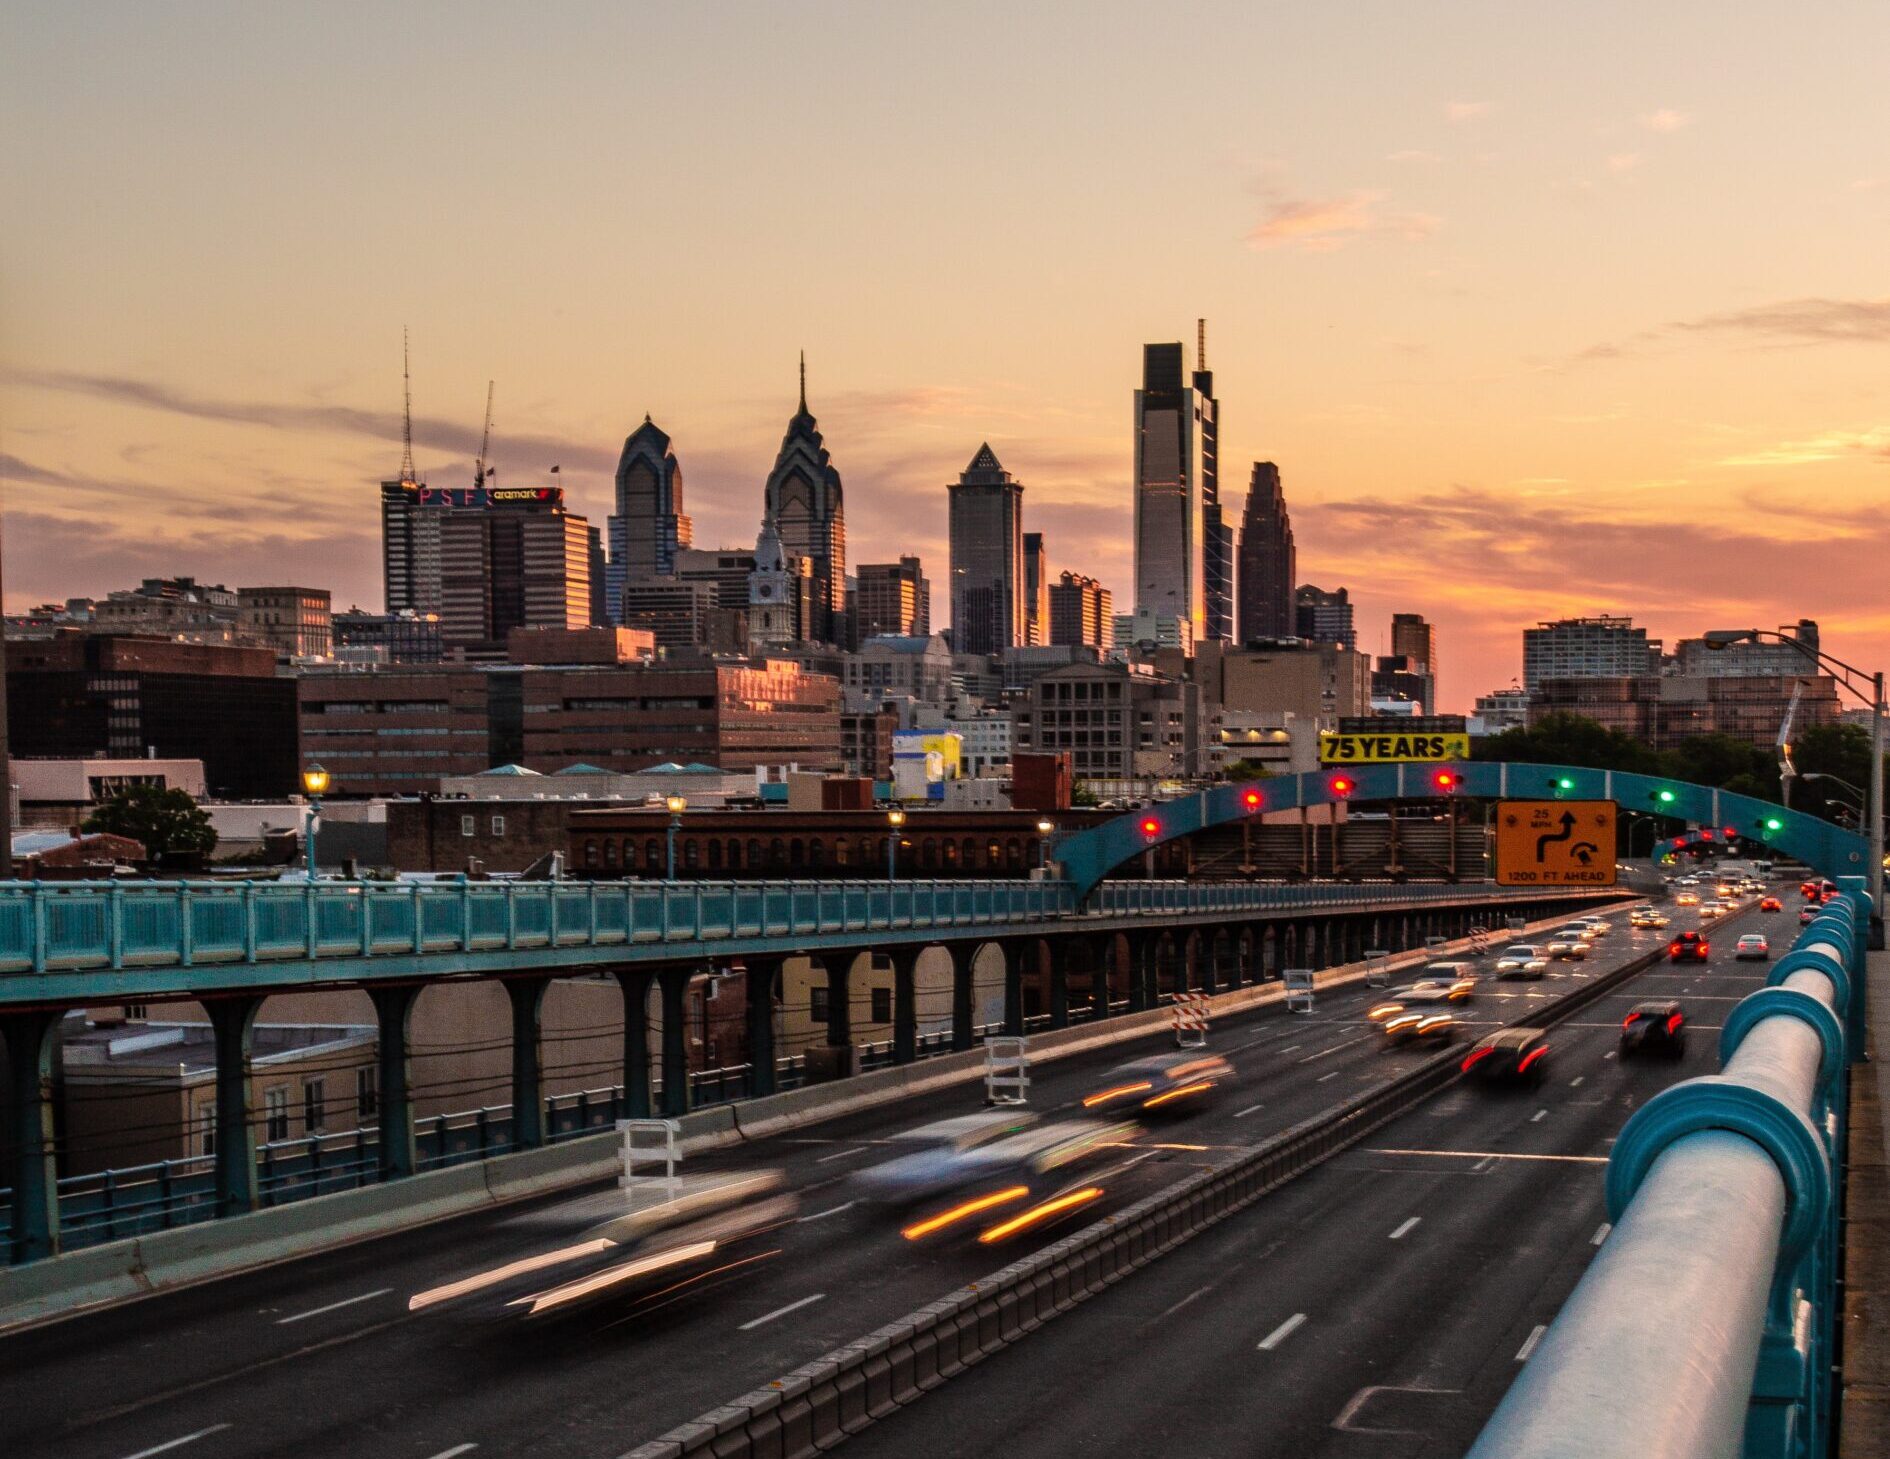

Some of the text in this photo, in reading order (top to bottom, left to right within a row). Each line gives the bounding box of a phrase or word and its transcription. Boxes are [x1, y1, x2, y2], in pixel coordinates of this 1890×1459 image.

[494, 489, 537, 500] aramark
[1325, 736, 1445, 759] 75 YEARS
[1534, 809, 1550, 819] 25
[1508, 871, 1605, 881] 1200 FT AHEAD
